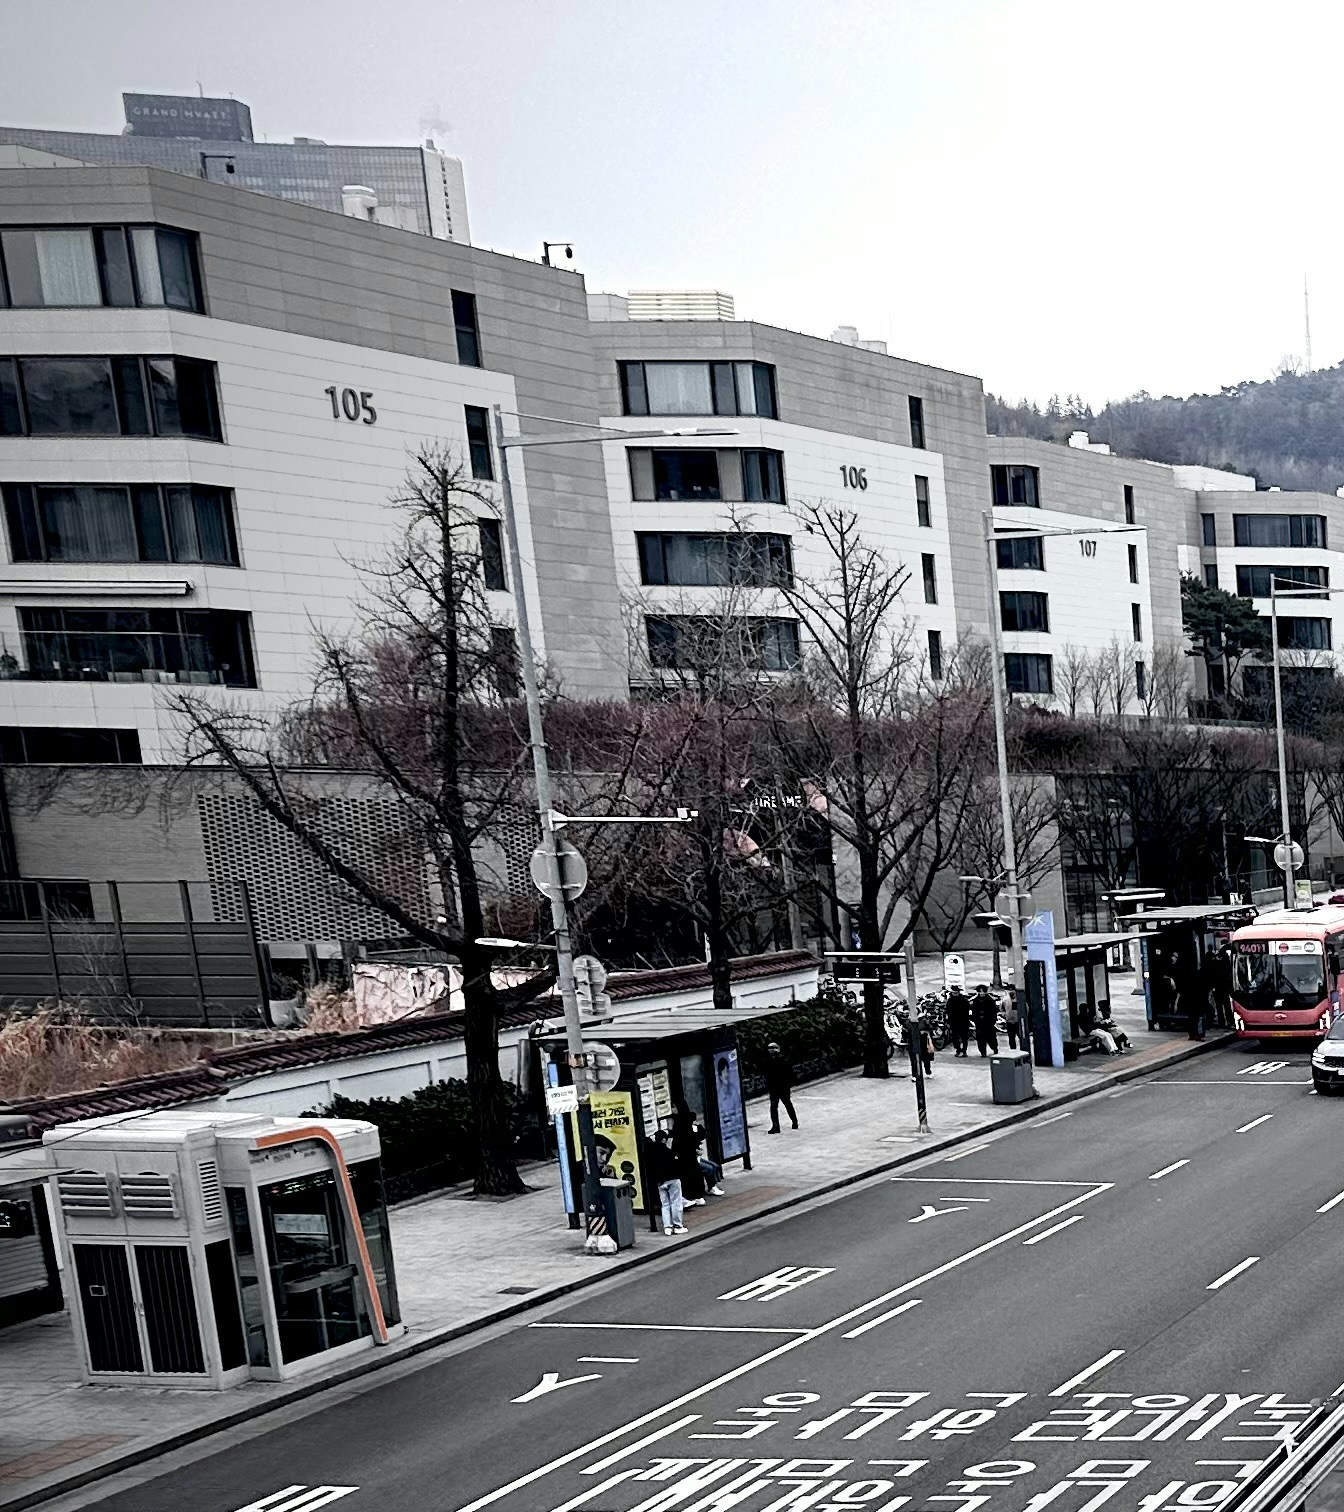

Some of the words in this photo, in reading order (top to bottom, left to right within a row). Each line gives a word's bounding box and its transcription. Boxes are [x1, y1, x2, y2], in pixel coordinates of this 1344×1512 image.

[132, 106, 178, 117] GRAND
[184, 110, 227, 119] HYATT
[324, 385, 377, 425] 105
[839, 464, 868, 491] 106
[1078, 539, 1097, 558] 107
